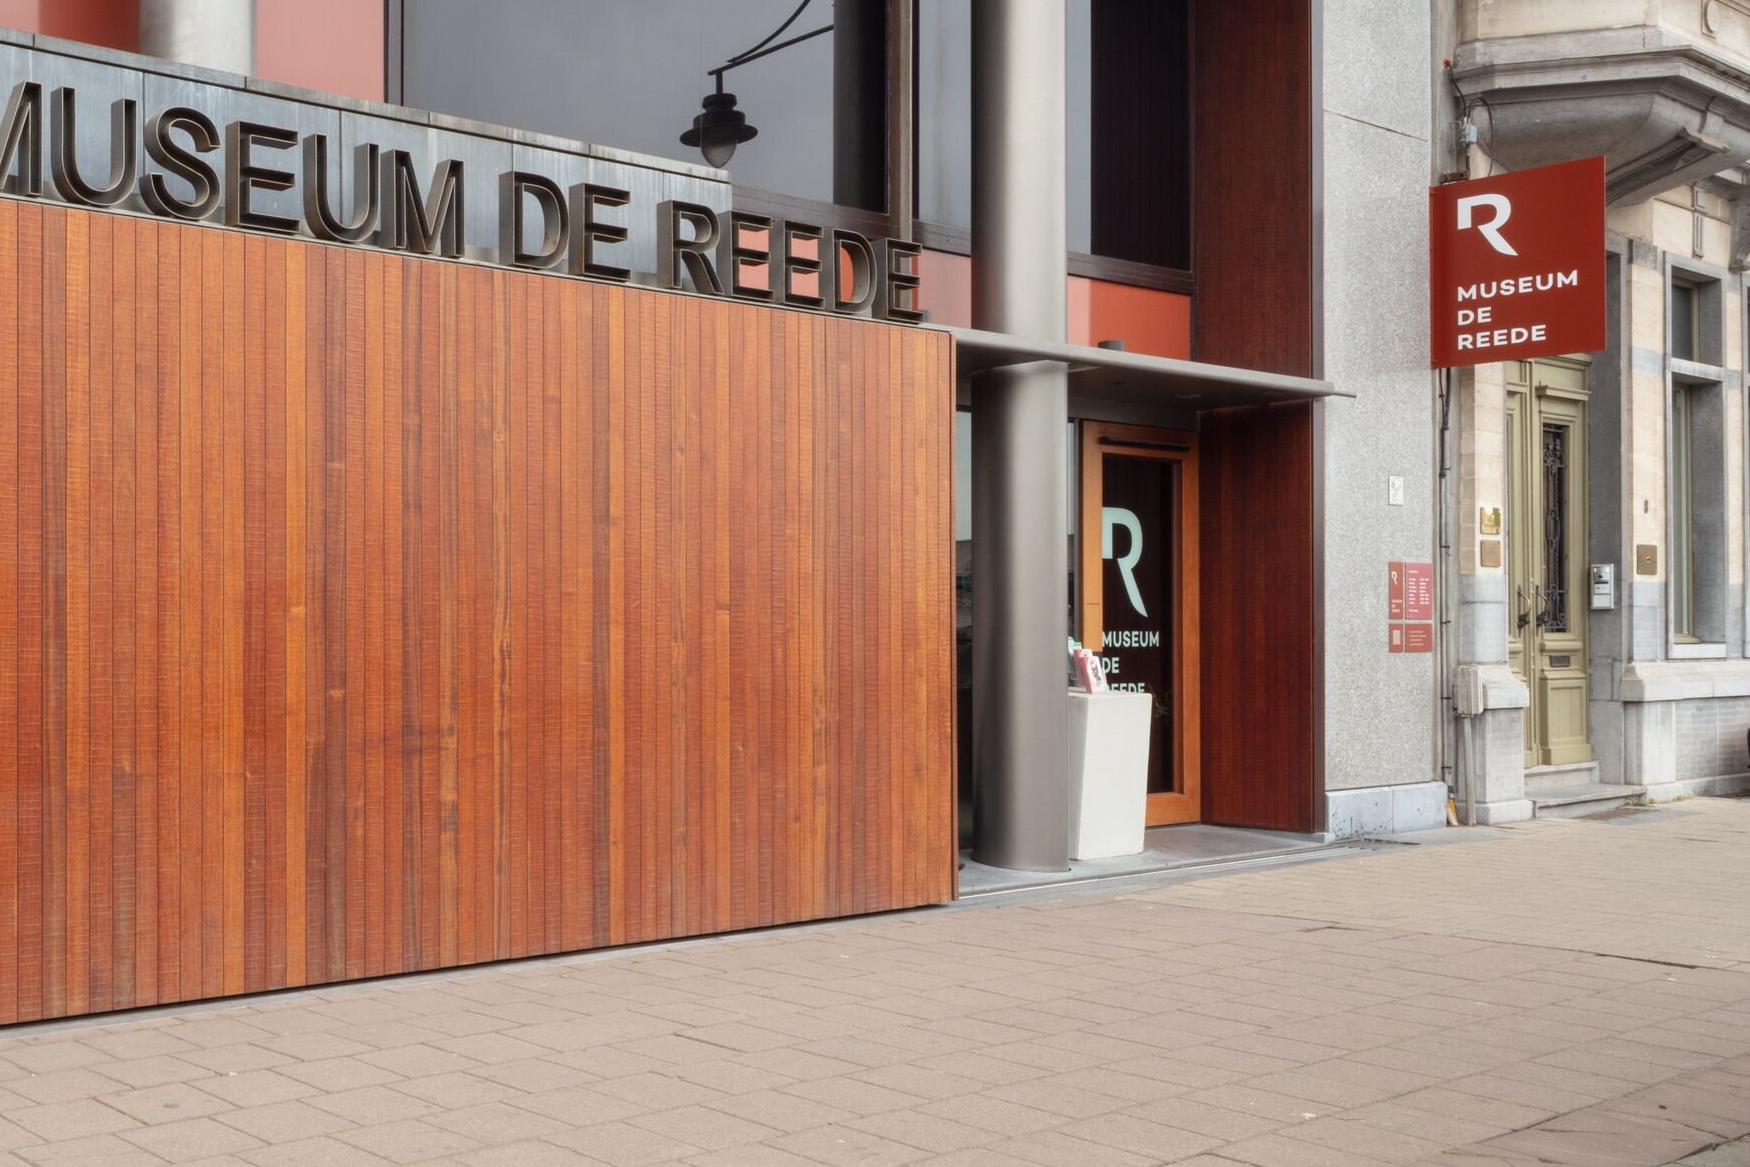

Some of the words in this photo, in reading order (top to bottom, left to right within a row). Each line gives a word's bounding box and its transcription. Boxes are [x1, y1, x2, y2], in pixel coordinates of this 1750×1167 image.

[1457, 193, 1518, 256] R
[498, 170, 631, 283] DE
[658, 199, 924, 324] REEDE
[1457, 270, 1578, 302] MUSEUM
[1457, 307, 1492, 326] DE
[1457, 324, 1547, 350] REEDE
[1101, 507, 1148, 617] R
[1102, 631, 1159, 647] MUSEUM
[1102, 657, 1120, 673] DE
